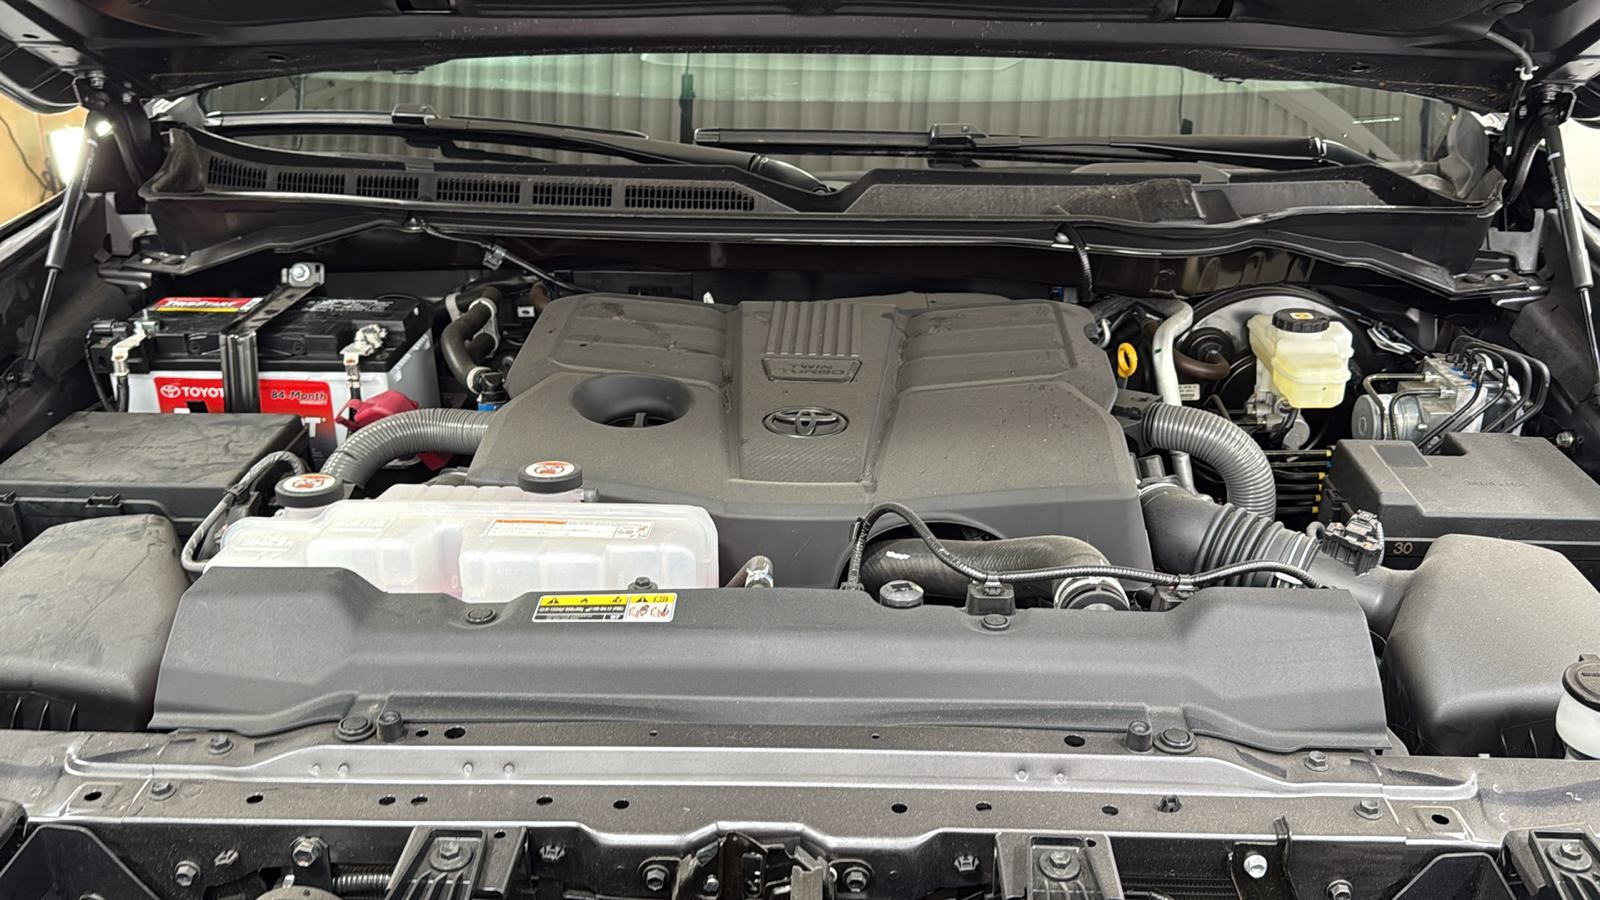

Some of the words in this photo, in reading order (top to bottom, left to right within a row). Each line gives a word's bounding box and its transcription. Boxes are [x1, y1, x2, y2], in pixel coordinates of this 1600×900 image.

[181, 386, 224, 398] TOYOT
[271, 390, 327, 401] 84-Month
[1393, 542, 1413, 554] 30
